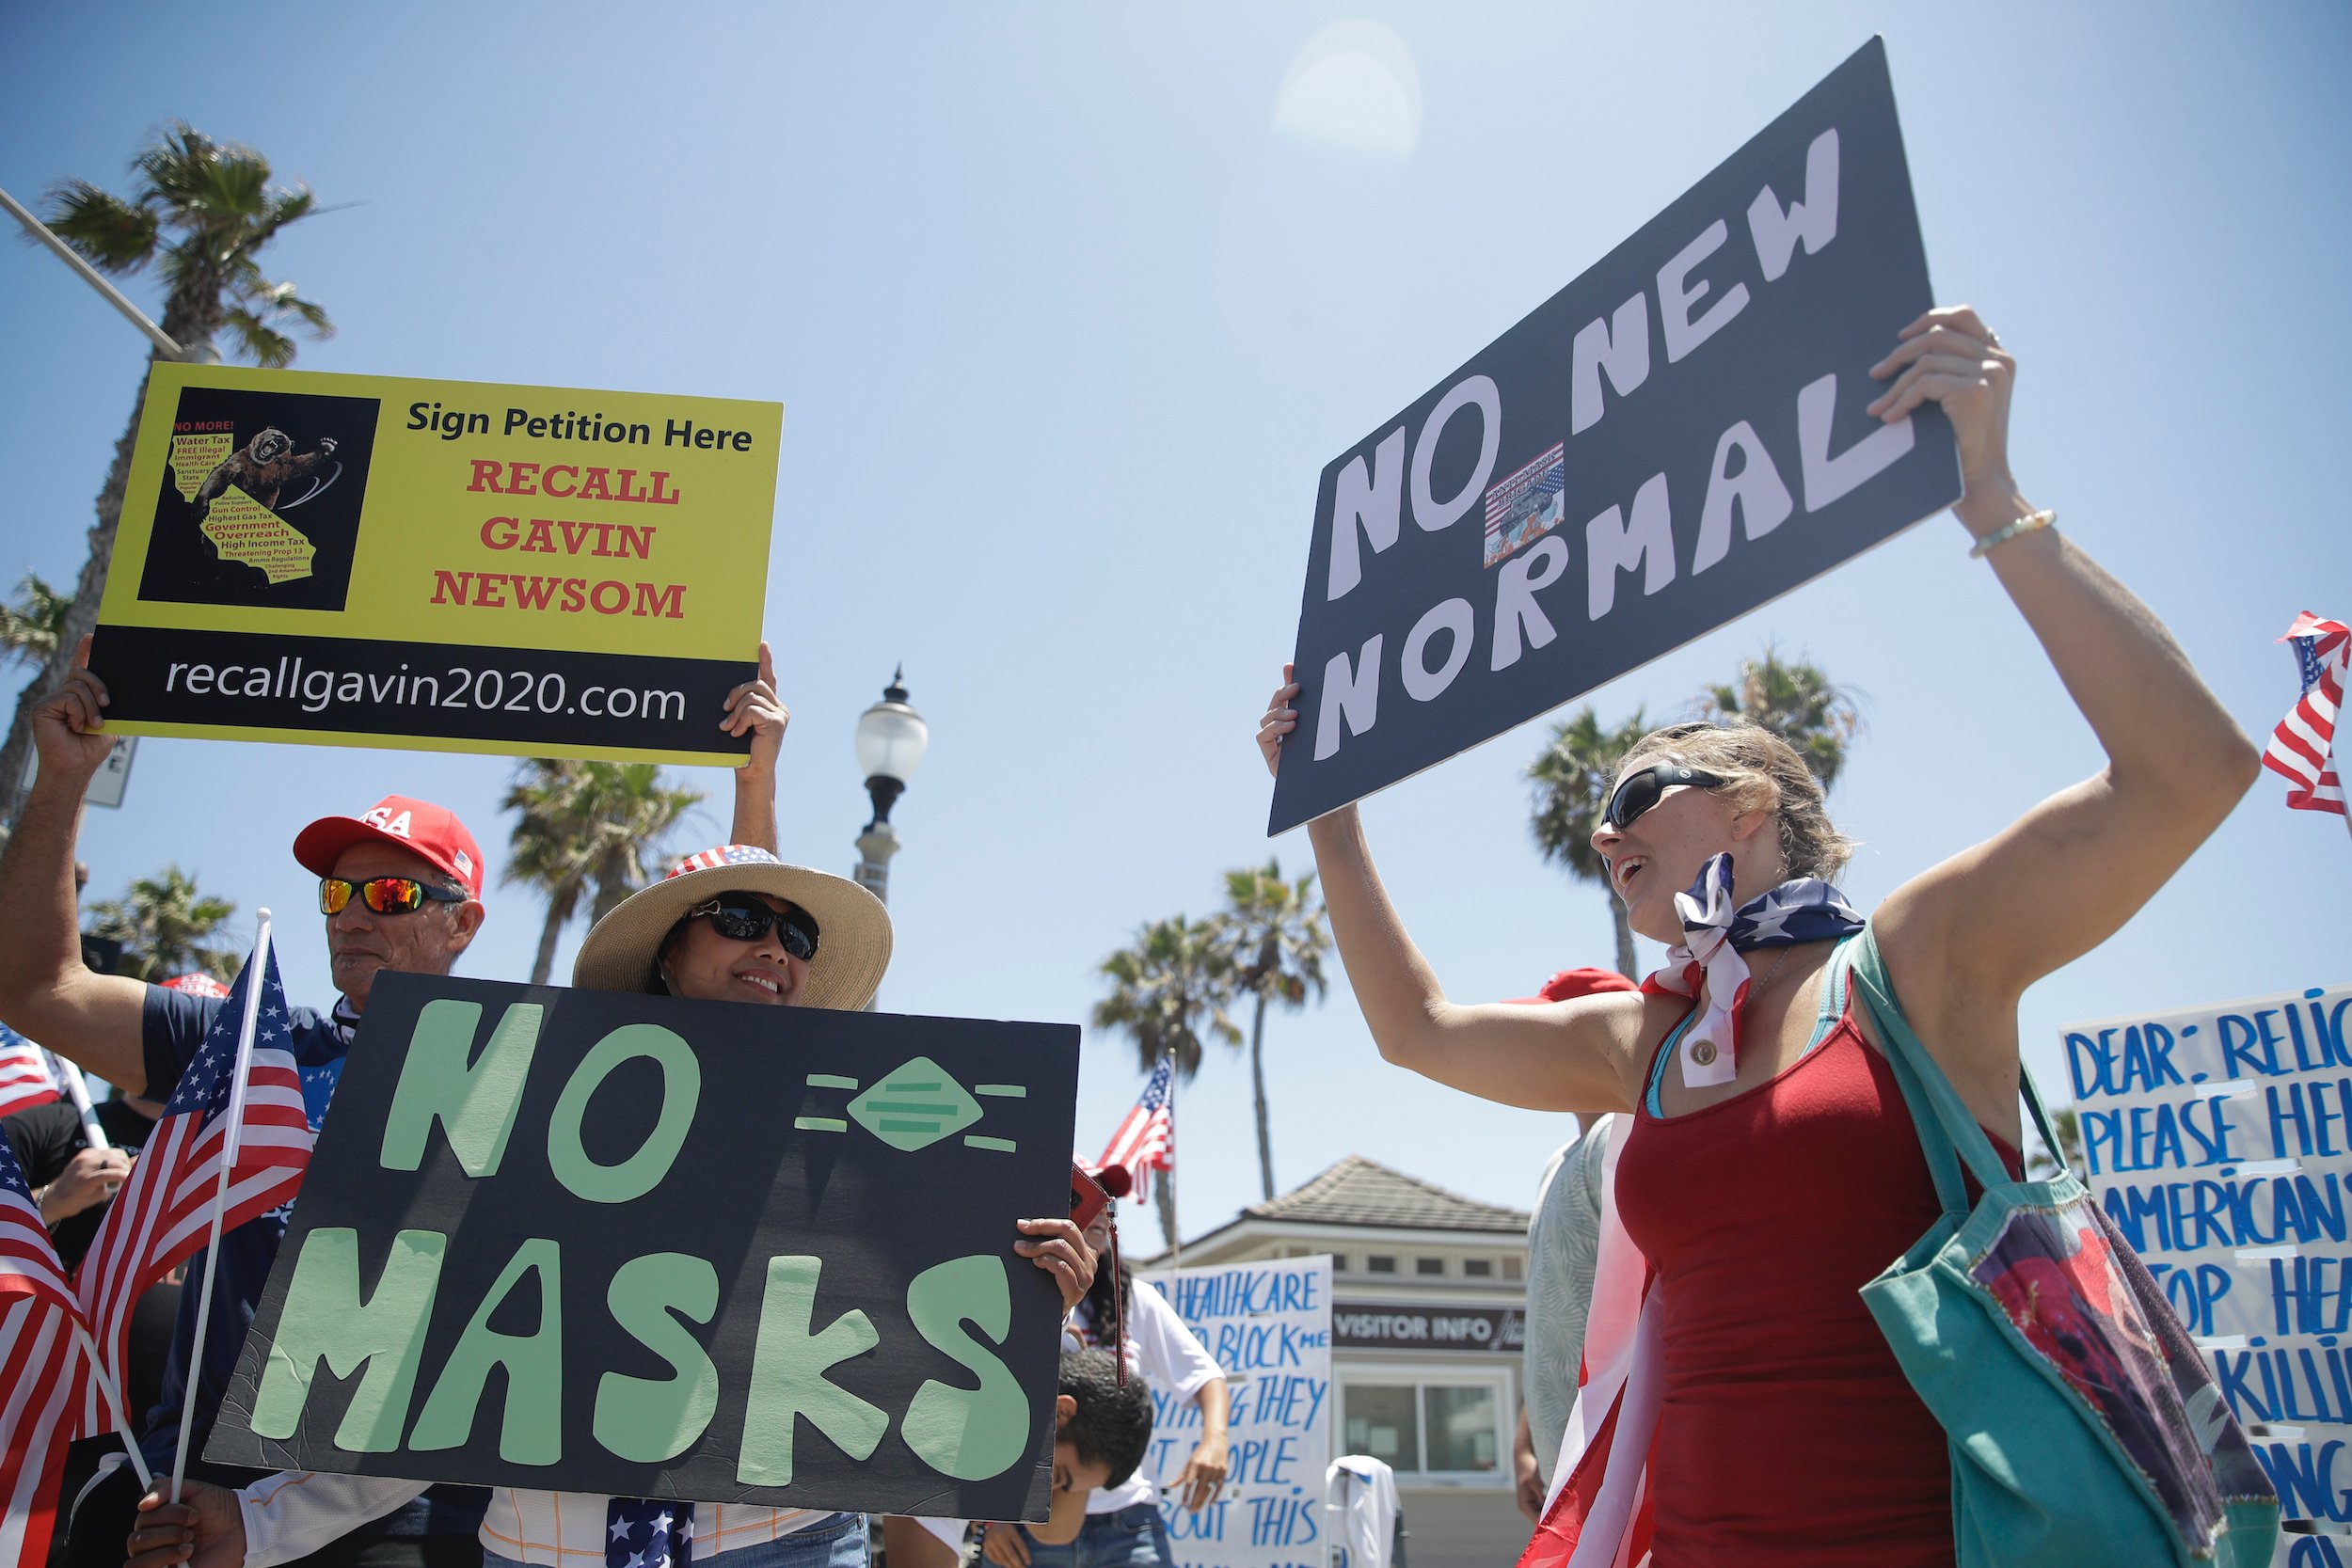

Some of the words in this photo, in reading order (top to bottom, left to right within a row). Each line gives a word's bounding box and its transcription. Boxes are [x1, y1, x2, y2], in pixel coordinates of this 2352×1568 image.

[1327, 375, 1502, 601] NO
[1572, 128, 1840, 436] NEW
[174, 422, 192, 432] NO
[195, 420, 234, 431] MORE!
[176, 436, 209, 446] Water
[211, 436, 230, 444] Tax
[406, 402, 490, 441] Sign
[504, 408, 650, 445] Petition
[664, 419, 753, 452] Here
[199, 446, 226, 454] Illegal
[466, 459, 680, 505] RECALL
[205, 520, 280, 531] Government
[208, 515, 240, 523] Highest
[215, 529, 289, 540] Overreach
[480, 516, 657, 560] GAVIN
[221, 540, 246, 550] High
[247, 539, 285, 547] Income
[225, 549, 272, 558] Threatening
[1314, 374, 1916, 761] NORMAL
[430, 570, 687, 619] NEWSOM
[166, 657, 687, 721] recallgavin2020.com
[358, 806, 411, 840] SA
[380, 999, 701, 1204] NO
[2080, 1095, 2245, 1176] PLEASE
[1176, 1271, 1319, 1322] HEALTHCARE
[1216, 1323, 1301, 1372] BLOCK
[1300, 1330, 1328, 1348] ME
[1333, 1313, 1428, 1340] VISITOR
[1432, 1317, 1493, 1342] INFO
[1255, 1374, 1327, 1432] THEY
[1191, 1436, 1297, 1484] OPLE
